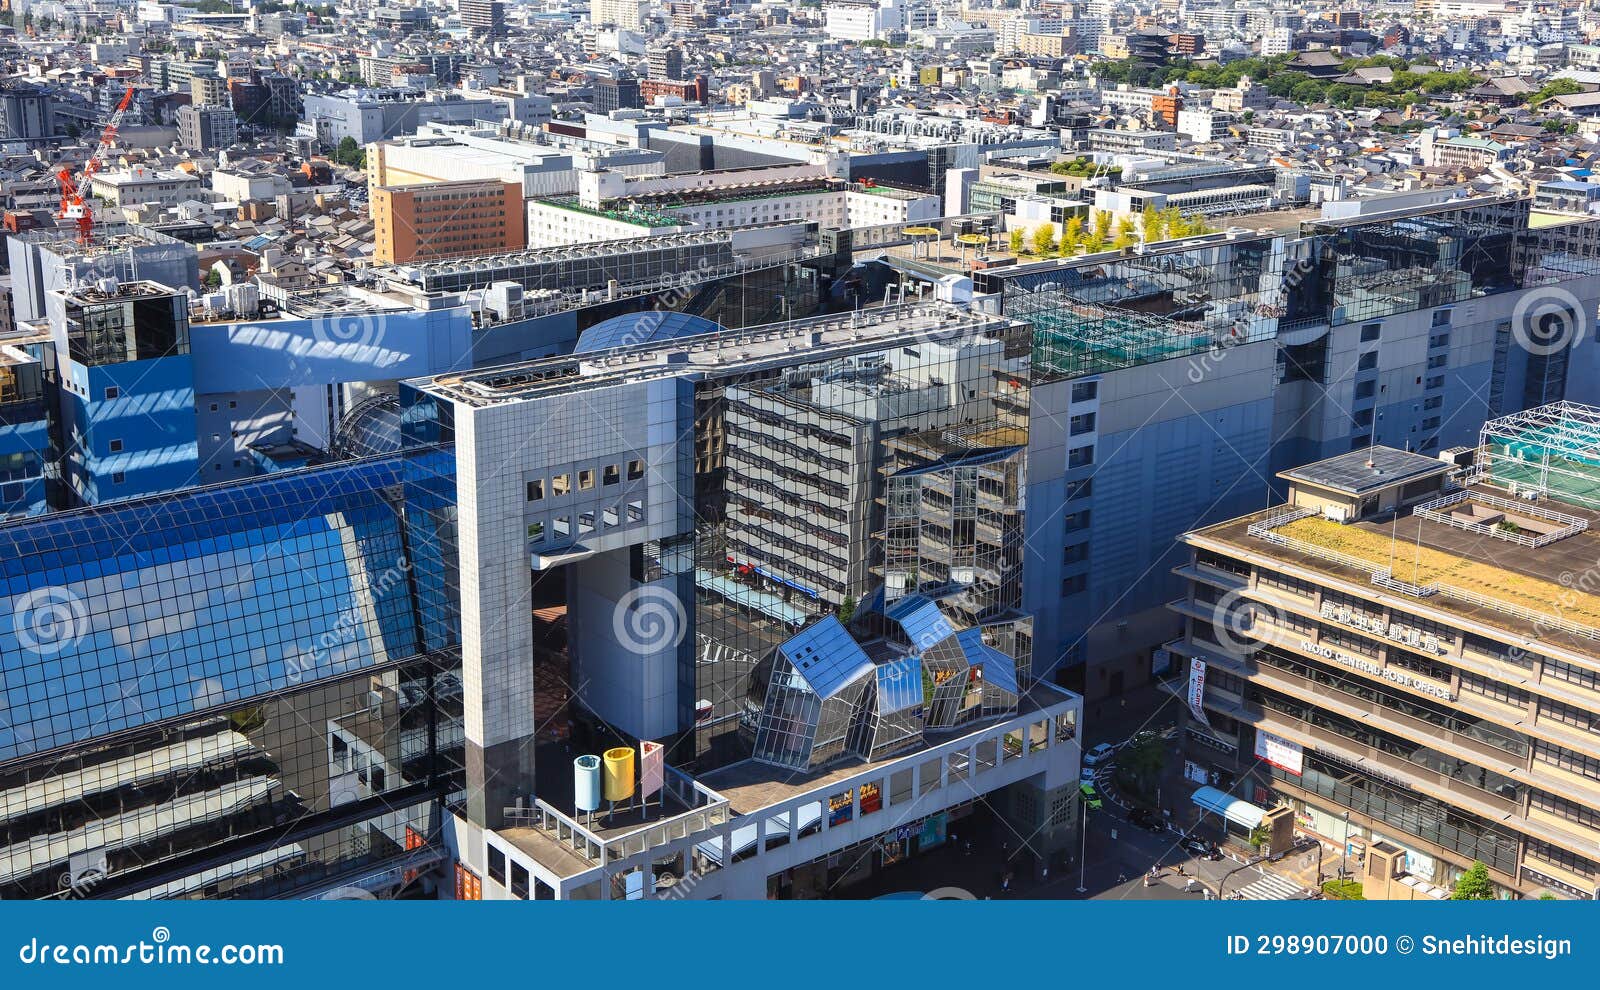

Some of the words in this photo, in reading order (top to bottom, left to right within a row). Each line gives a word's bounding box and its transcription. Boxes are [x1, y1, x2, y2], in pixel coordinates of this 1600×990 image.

[1320, 598, 1440, 655] 京都中央郵便局
[1300, 639, 1332, 658] KYOTO
[1335, 652, 1381, 676] CENTRAL
[1383, 667, 1412, 687] POST
[1413, 680, 1450, 700] OFFICE
